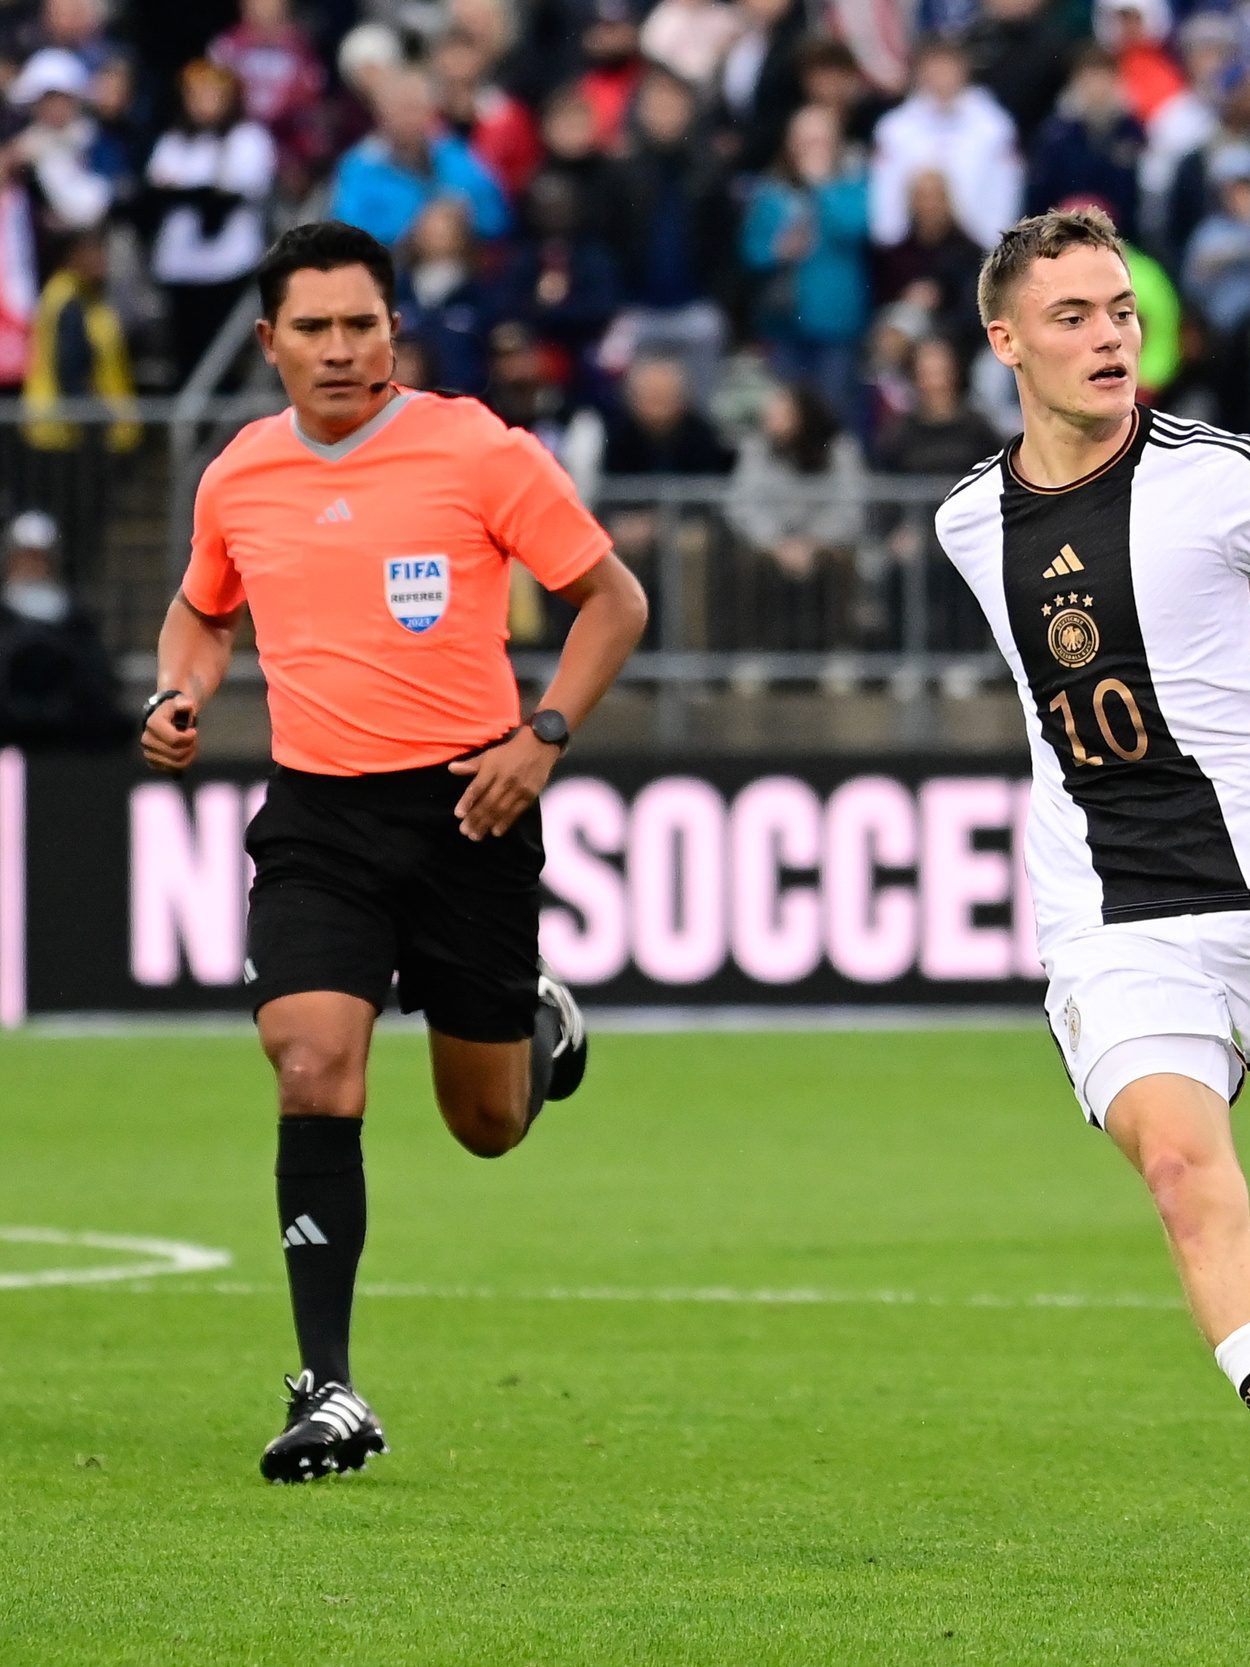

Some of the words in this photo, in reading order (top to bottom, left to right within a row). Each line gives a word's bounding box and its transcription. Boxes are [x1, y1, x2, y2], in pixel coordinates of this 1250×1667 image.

[390, 561, 441, 579] FIFA
[391, 592, 442, 602] REFEREE
[406, 619, 430, 628] 2023
[1050, 678, 1148, 766] 10
